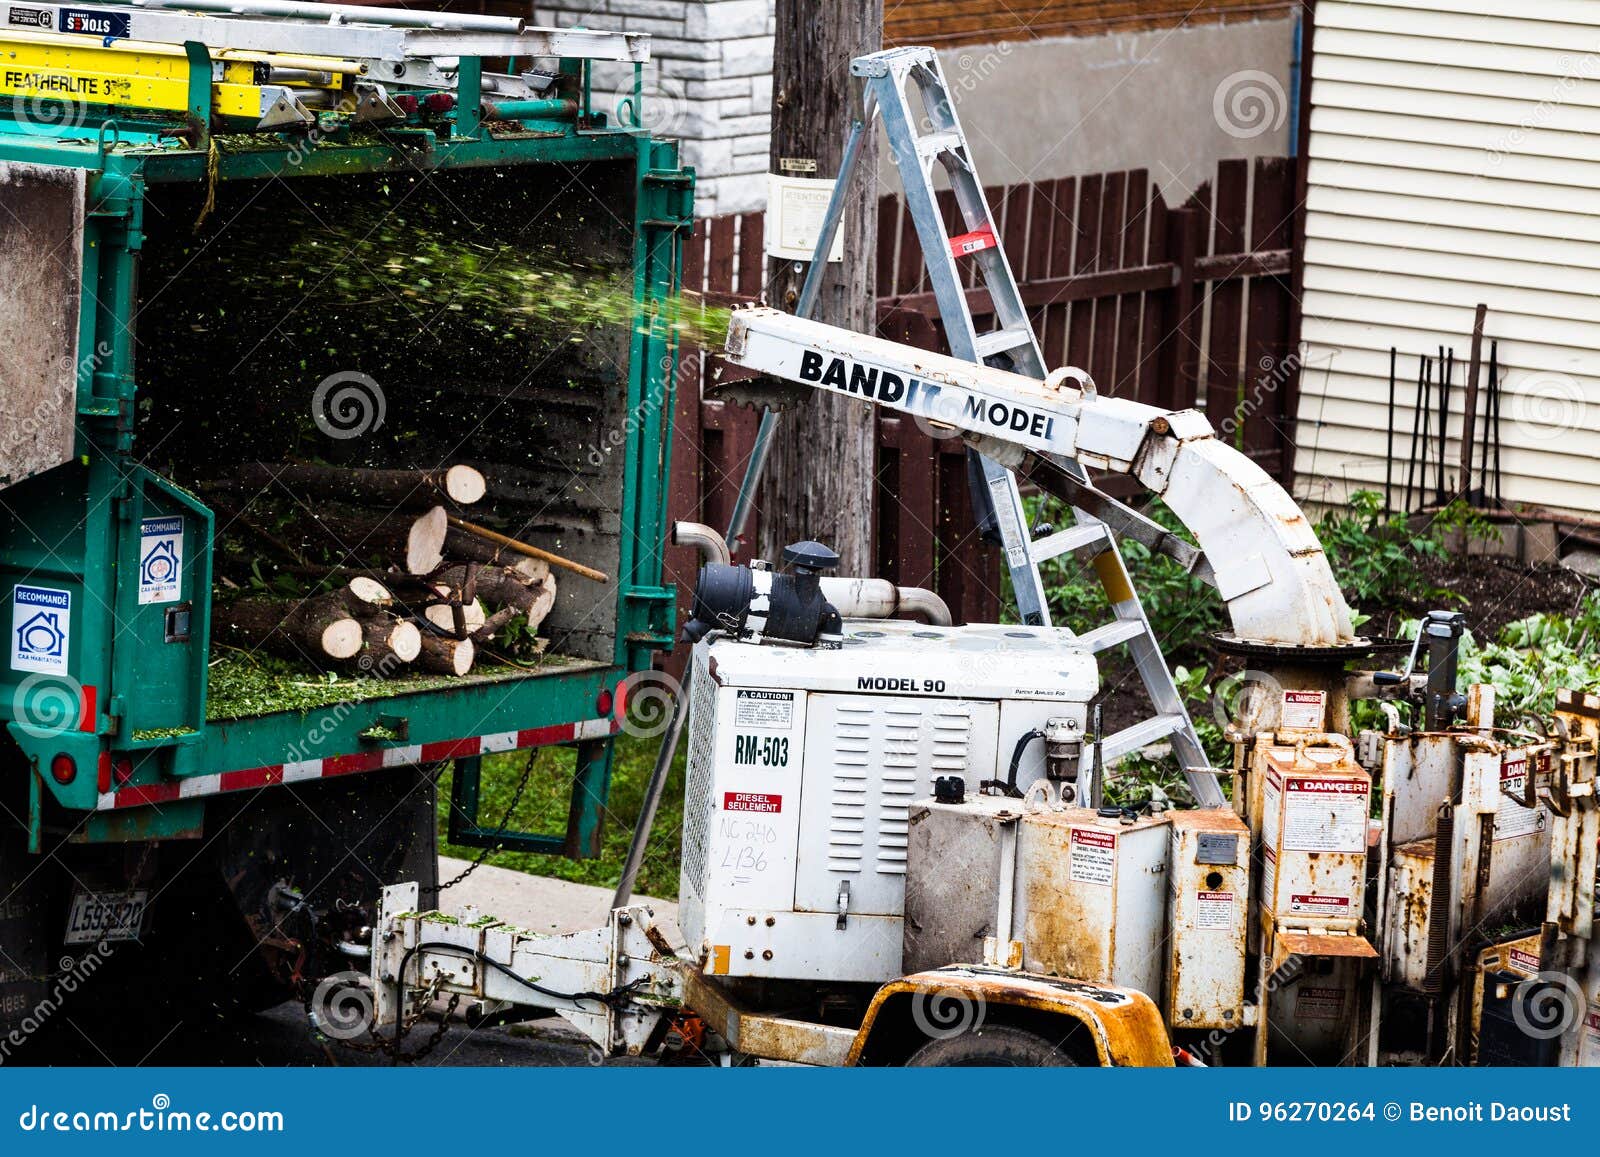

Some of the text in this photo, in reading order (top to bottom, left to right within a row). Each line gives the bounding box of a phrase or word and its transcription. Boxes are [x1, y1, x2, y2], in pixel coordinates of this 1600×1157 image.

[5, 71, 98, 94] FEATHERLITE
[799, 350, 1055, 441] BANDIT MODEL
[17, 591, 67, 606] RECOMMANDÉ
[857, 676, 946, 693] MODEL 90
[750, 691, 792, 700] CAUTION!
[735, 735, 789, 767] RM-503
[1303, 782, 1368, 792] DANGER!
[736, 793, 770, 803] DIESEL
[728, 801, 778, 812] SEULEMENT
